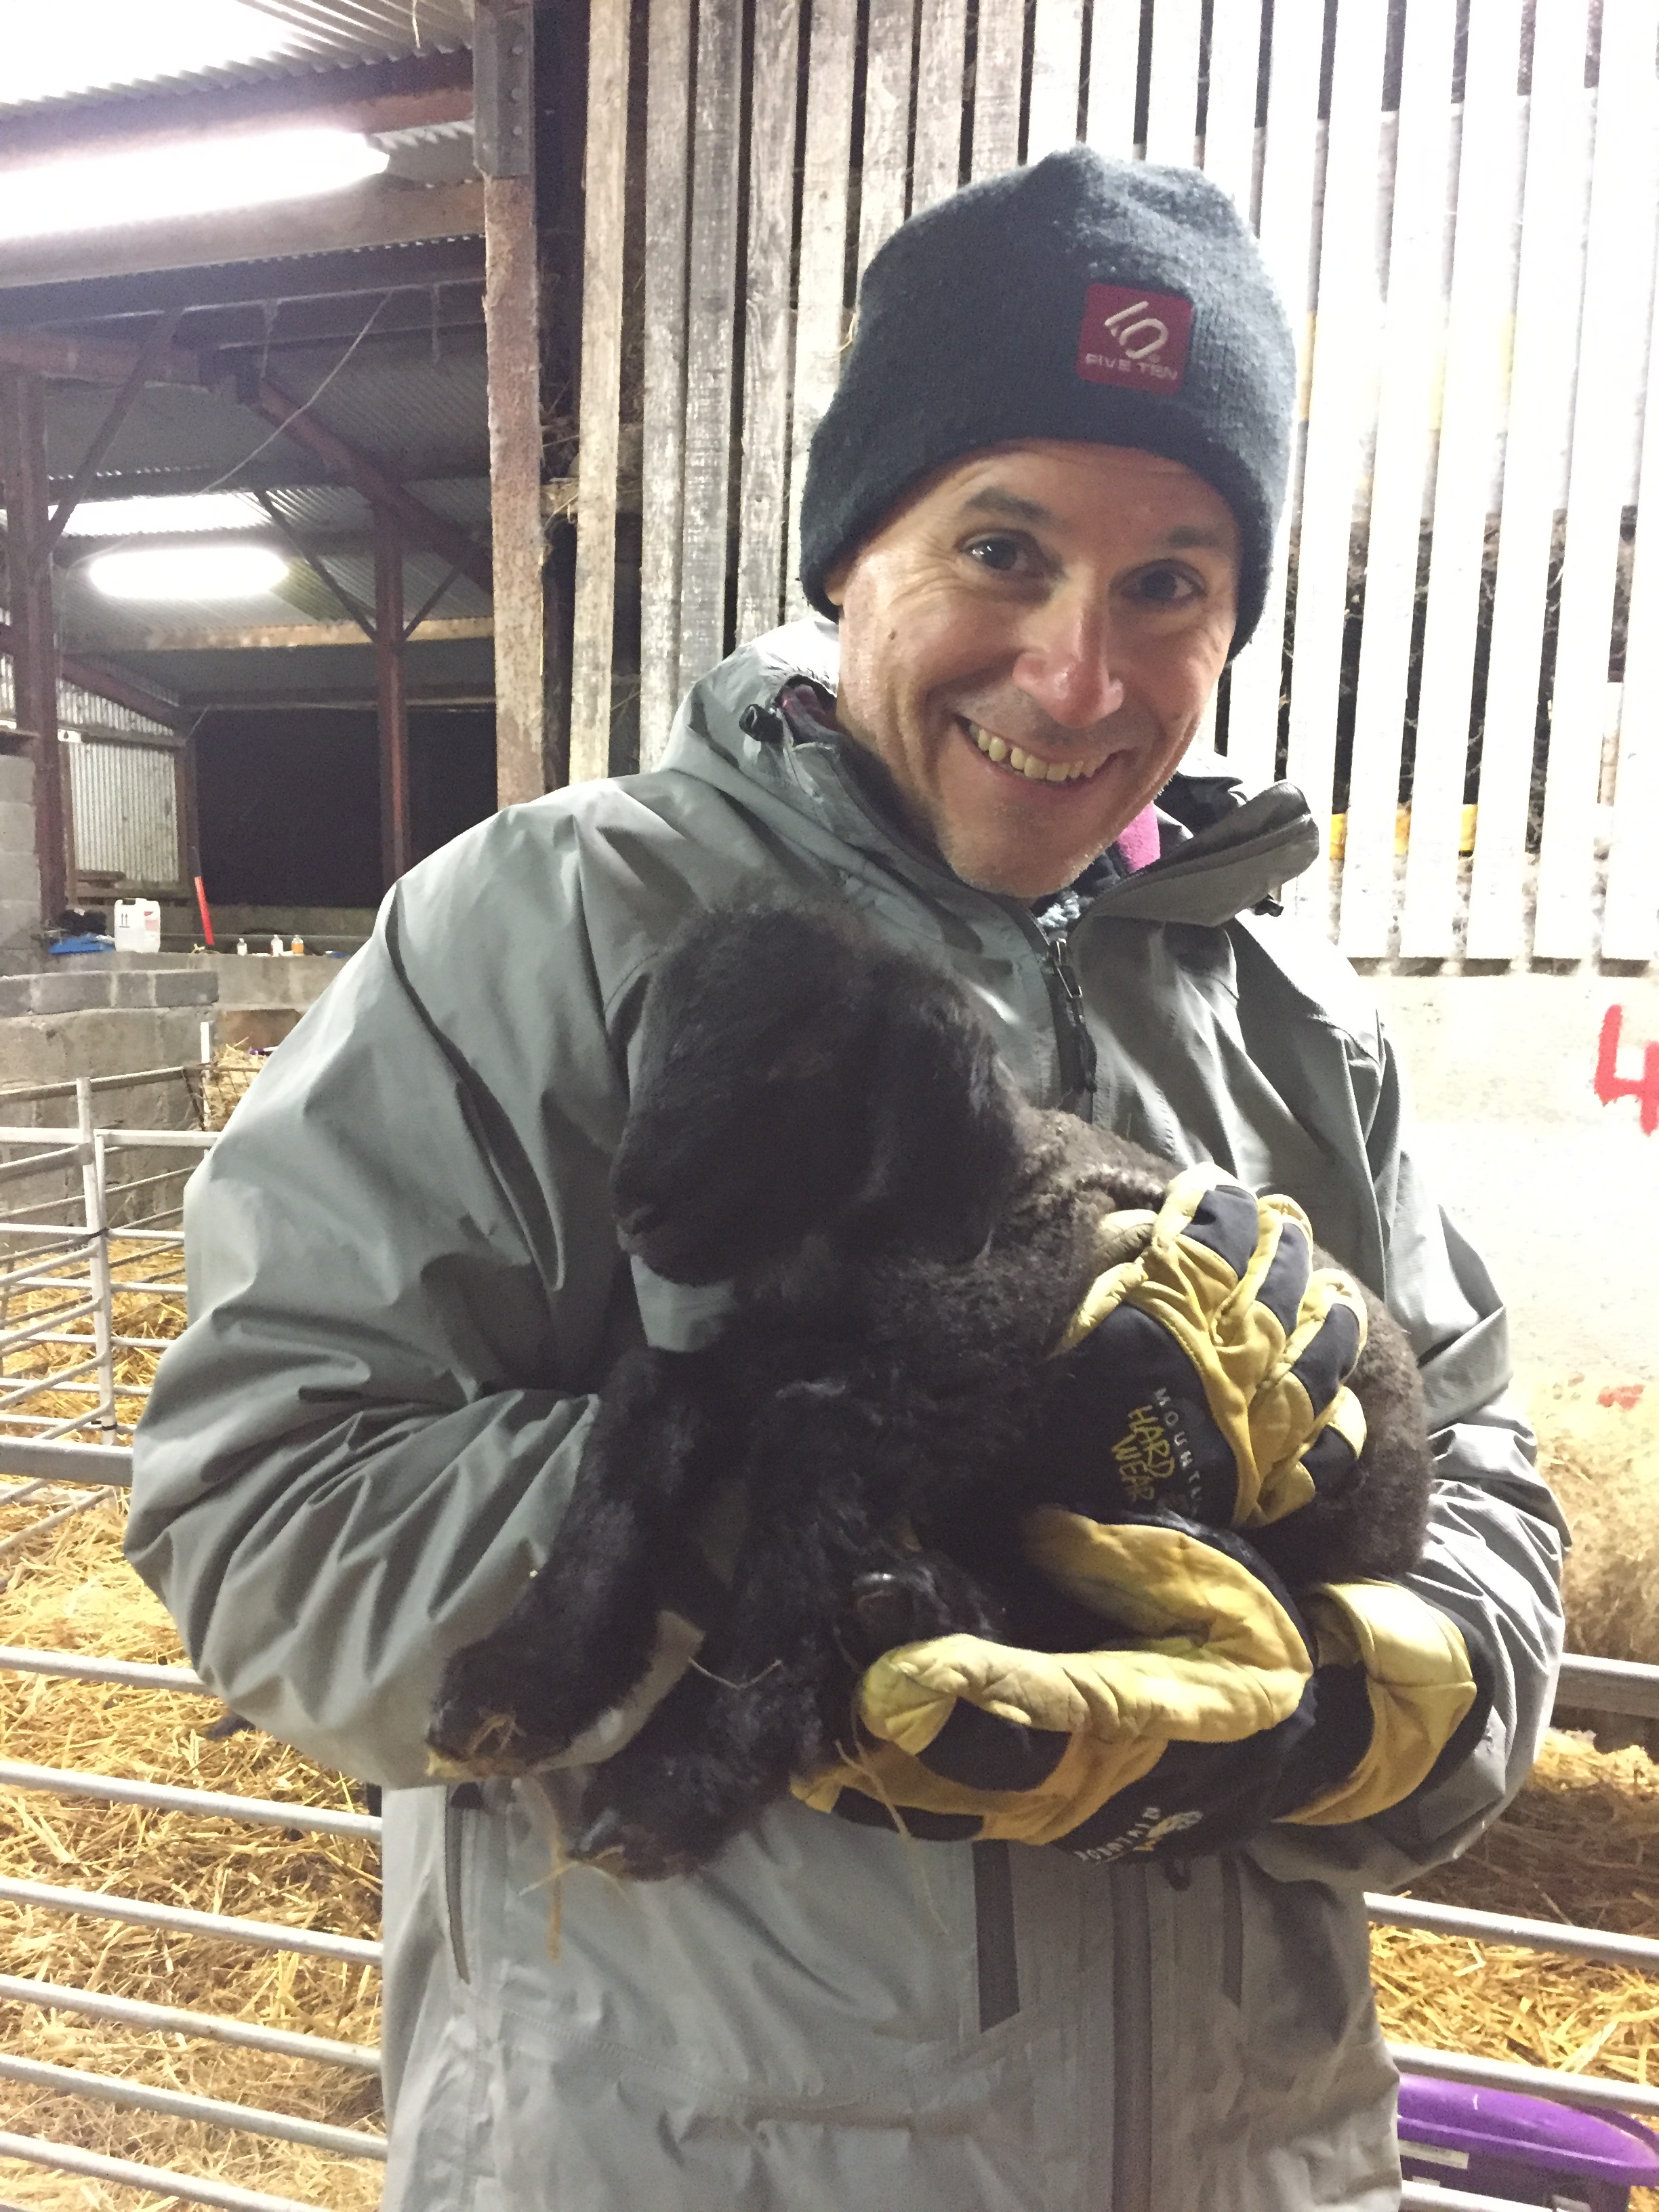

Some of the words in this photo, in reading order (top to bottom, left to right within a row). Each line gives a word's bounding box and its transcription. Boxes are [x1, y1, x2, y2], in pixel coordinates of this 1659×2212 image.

[1085, 352, 1131, 373] FIVE
[1138, 361, 1178, 380] TEN
[1594, 1003, 1659, 1136] 4
